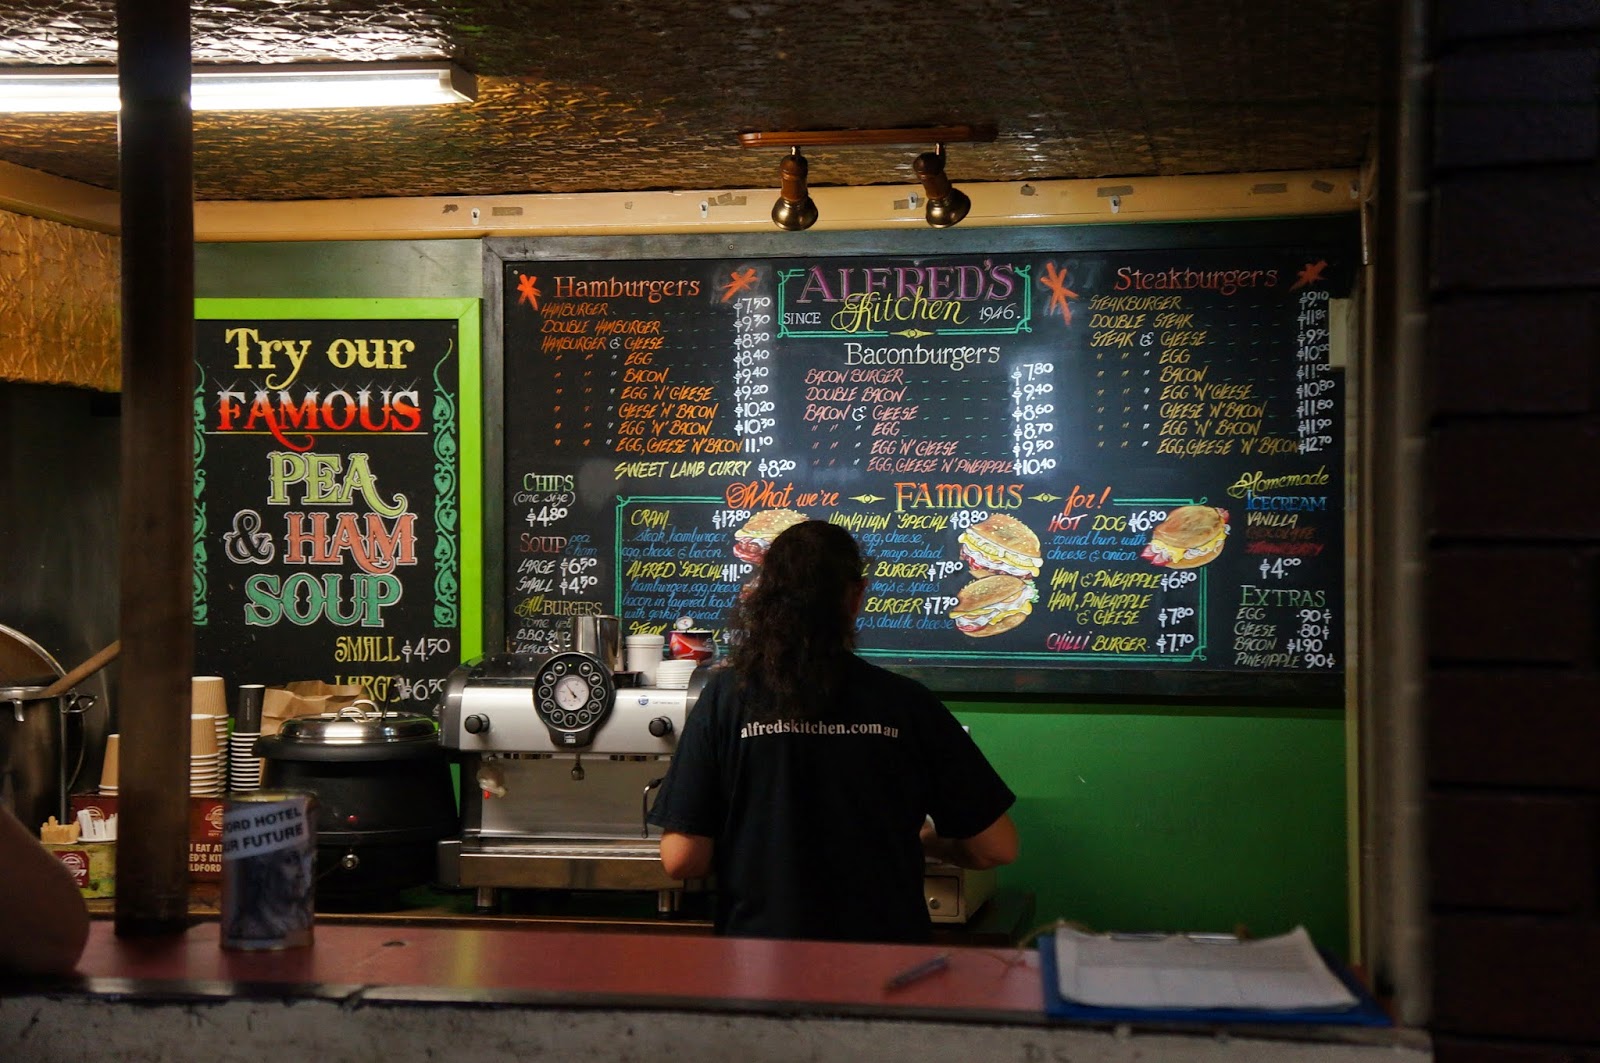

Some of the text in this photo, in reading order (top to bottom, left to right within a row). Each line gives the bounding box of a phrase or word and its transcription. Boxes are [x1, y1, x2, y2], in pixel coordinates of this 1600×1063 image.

[553, 275, 701, 304] Hamburgers
[796, 259, 1016, 304] ALFRED'S
[1112, 266, 1280, 296] Steakburgers
[541, 296, 771, 319] HAMBURGER $7.50
[830, 285, 970, 334] Kitchen
[1088, 295, 1182, 311] STEAKBURGER
[540, 320, 588, 334] DOUBLE
[594, 320, 662, 337] HAMBURGER
[783, 311, 822, 326] SINCE
[1088, 313, 1194, 330] DOUBLE STEAK
[541, 337, 608, 354] HAMBURGER
[624, 337, 665, 351] CHEESE
[1090, 331, 1208, 348] STEAK CHEESE
[225, 327, 416, 390] Try our
[624, 349, 770, 369] EGG $8.40
[843, 342, 1001, 374] Baconburgers
[1158, 349, 1191, 365] EGG
[623, 366, 769, 385] BACON $9.40
[804, 363, 1055, 387] BACON BURGER $7.80
[1159, 366, 1209, 385] BACON
[620, 384, 769, 403] EGG CHEESE $9.20
[804, 383, 1054, 405] DOUBLE BACON $9.40
[1159, 380, 1336, 401] EGG CHEESE $10.80
[215, 389, 423, 452] FAMOUS
[618, 401, 776, 421] CHEESE BACON $10.20
[803, 404, 848, 422] BACON
[872, 405, 919, 422] CHEESE
[1159, 402, 1205, 419] CHEESE
[1226, 401, 1268, 420] BACON
[618, 421, 646, 436] EGG
[669, 419, 713, 436] BACON
[872, 422, 902, 437] EGG
[1158, 420, 1188, 436] EGG
[1215, 420, 1263, 436] BACON
[870, 441, 897, 455] EGG
[915, 441, 960, 456] CHEESE
[1258, 439, 1300, 455] BACON
[613, 458, 797, 481] SWEET LAMB CURRY $8.20
[1012, 458, 1057, 477] $10.40
[267, 451, 409, 518] PEA
[523, 472, 575, 492] CHIPS
[1227, 465, 1330, 499] Homemade
[725, 479, 1112, 516] What we're FAMOUS for!
[1244, 489, 1328, 512] ICECREAM
[525, 505, 569, 528] $4.80
[949, 510, 989, 530] $8.80
[1047, 510, 1167, 533] HOT DOG $6.80
[223, 508, 419, 575] & HAM
[519, 532, 568, 554] SOUP
[1091, 530, 1147, 546] bun with
[880, 549, 909, 563] mayo
[910, 544, 945, 559] salad
[1046, 546, 1139, 561] cheese onion
[517, 557, 598, 577] LARGE $6.50
[626, 560, 677, 581] ALFRED
[874, 561, 930, 580] BURGER
[927, 560, 964, 582] $7.80
[1259, 557, 1302, 580] $4.00
[515, 576, 554, 594] SMALL
[907, 579, 941, 597] spices
[1050, 567, 1079, 591] HAM
[1160, 571, 1198, 592] $6.80
[245, 572, 404, 628] SOUP
[865, 596, 924, 616] BURGER
[1239, 584, 1327, 608] EXTRAS
[542, 600, 603, 616] BURGERS
[1093, 609, 1140, 626] CHEESE
[1236, 607, 1267, 621] EGG
[876, 614, 914, 629] double
[916, 615, 955, 630] cheese
[1234, 620, 1278, 637] CHEESE
[334, 635, 451, 663] SMALL $4.50
[1233, 636, 1278, 652] BACON
[741, 719, 899, 739] alfredskitchen.comau
[225, 818, 250, 833] ORD
[254, 807, 302, 828] HOTEL
[242, 822, 304, 849] FUTURE
[188, 853, 223, 863] ED'S KIT
[189, 843, 194, 853] I
[195, 843, 212, 853] EAT
[188, 863, 222, 873] LDFORD
